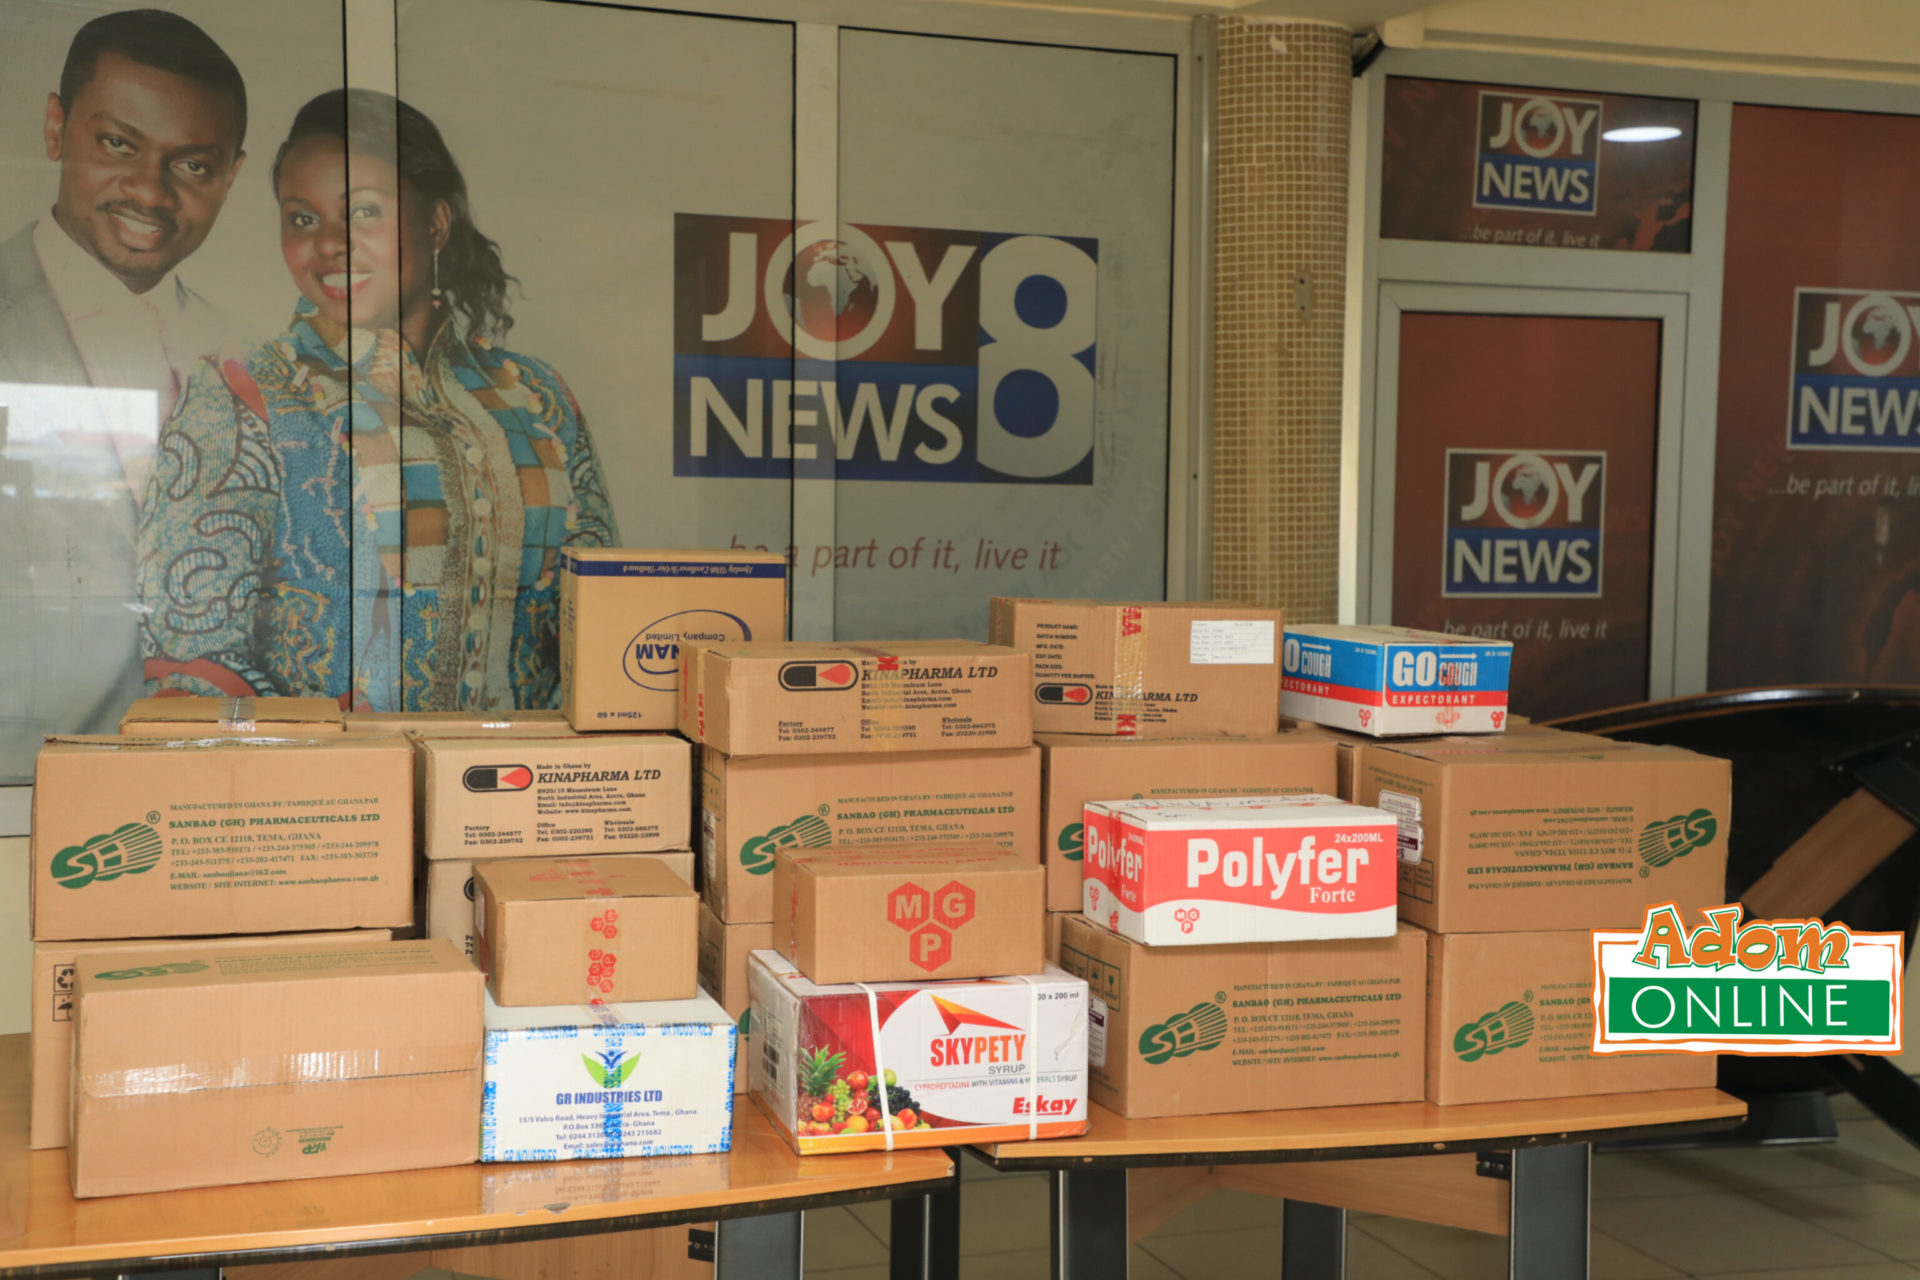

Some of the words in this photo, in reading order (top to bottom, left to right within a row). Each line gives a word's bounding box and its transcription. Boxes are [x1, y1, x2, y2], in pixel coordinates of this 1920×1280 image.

[1489, 99, 1597, 158] JOY
[1481, 163, 1589, 204] NEWS
[702, 220, 977, 361] JOY
[1809, 293, 1920, 377] JO
[1799, 387, 1920, 436] NEW
[690, 376, 963, 464] NEWS
[1461, 453, 1599, 529] JOY
[1814, 475, 1854, 500] part
[1859, 474, 1881, 496] of
[812, 538, 878, 576] part
[889, 535, 927, 568] of
[933, 538, 960, 573] it,
[975, 538, 1028, 569] live
[1039, 540, 1061, 569] it
[1453, 538, 1592, 584] NEWS
[645, 632, 680, 641] Limited
[683, 631, 725, 642] Company
[1471, 621, 1508, 638] part
[1512, 619, 1532, 638] of
[1559, 619, 1590, 638] live
[1595, 620, 1607, 638] it
[967, 666, 998, 679] LTD
[1301, 650, 1332, 679] COUGH
[1392, 650, 1438, 687] GO
[1439, 662, 1478, 687] COUGH
[1174, 692, 1199, 702] LTD
[1392, 694, 1476, 705] EXPECTORANT
[617, 711, 642, 719] 125ml
[537, 771, 629, 784] KINAPHARMA
[634, 769, 661, 781] LTD
[837, 811, 876, 820] SANBAO
[879, 810, 901, 820] (GH)
[903, 807, 996, 818] PHARMACEUTICALS
[998, 805, 1015, 814] LTD
[169, 820, 217, 829] SANBAO
[220, 818, 246, 828] (GH)
[249, 814, 358, 826] PHARMACEUTICALS
[360, 813, 380, 822] LTD
[193, 836, 213, 845] BOX
[288, 832, 322, 840] GHANA
[1334, 832, 1384, 844] 24x200ML
[1088, 824, 1142, 883] Polyfer
[1187, 835, 1370, 900] Polyfer
[1467, 866, 1483, 875] LTD
[1486, 863, 1571, 874] PHARMACEUTICALS
[1597, 861, 1634, 869] SANBAO
[1309, 886, 1356, 904] Forte
[895, 894, 922, 919] M
[942, 892, 966, 919] G
[920, 933, 942, 962] P
[1069, 991, 1079, 999] ml
[1232, 999, 1270, 1008] SANBAO
[1273, 998, 1294, 1008] (GH)
[1296, 994, 1384, 1005] PHARMACEUTICALS
[1385, 993, 1402, 1001] LTD
[1539, 997, 1575, 1007] SANBAO
[930, 1034, 1027, 1067] SKYPETY
[988, 1063, 1026, 1075] SYRUP
[971, 1079, 988, 1088] WITH
[989, 1077, 1019, 1086] VITAMINS
[1057, 1074, 1078, 1083] SYRUP
[556, 1092, 572, 1105] GR
[574, 1090, 642, 1105] INDUSTRIES
[644, 1089, 663, 1102] LTD
[576, 1113, 598, 1121] Heavy
